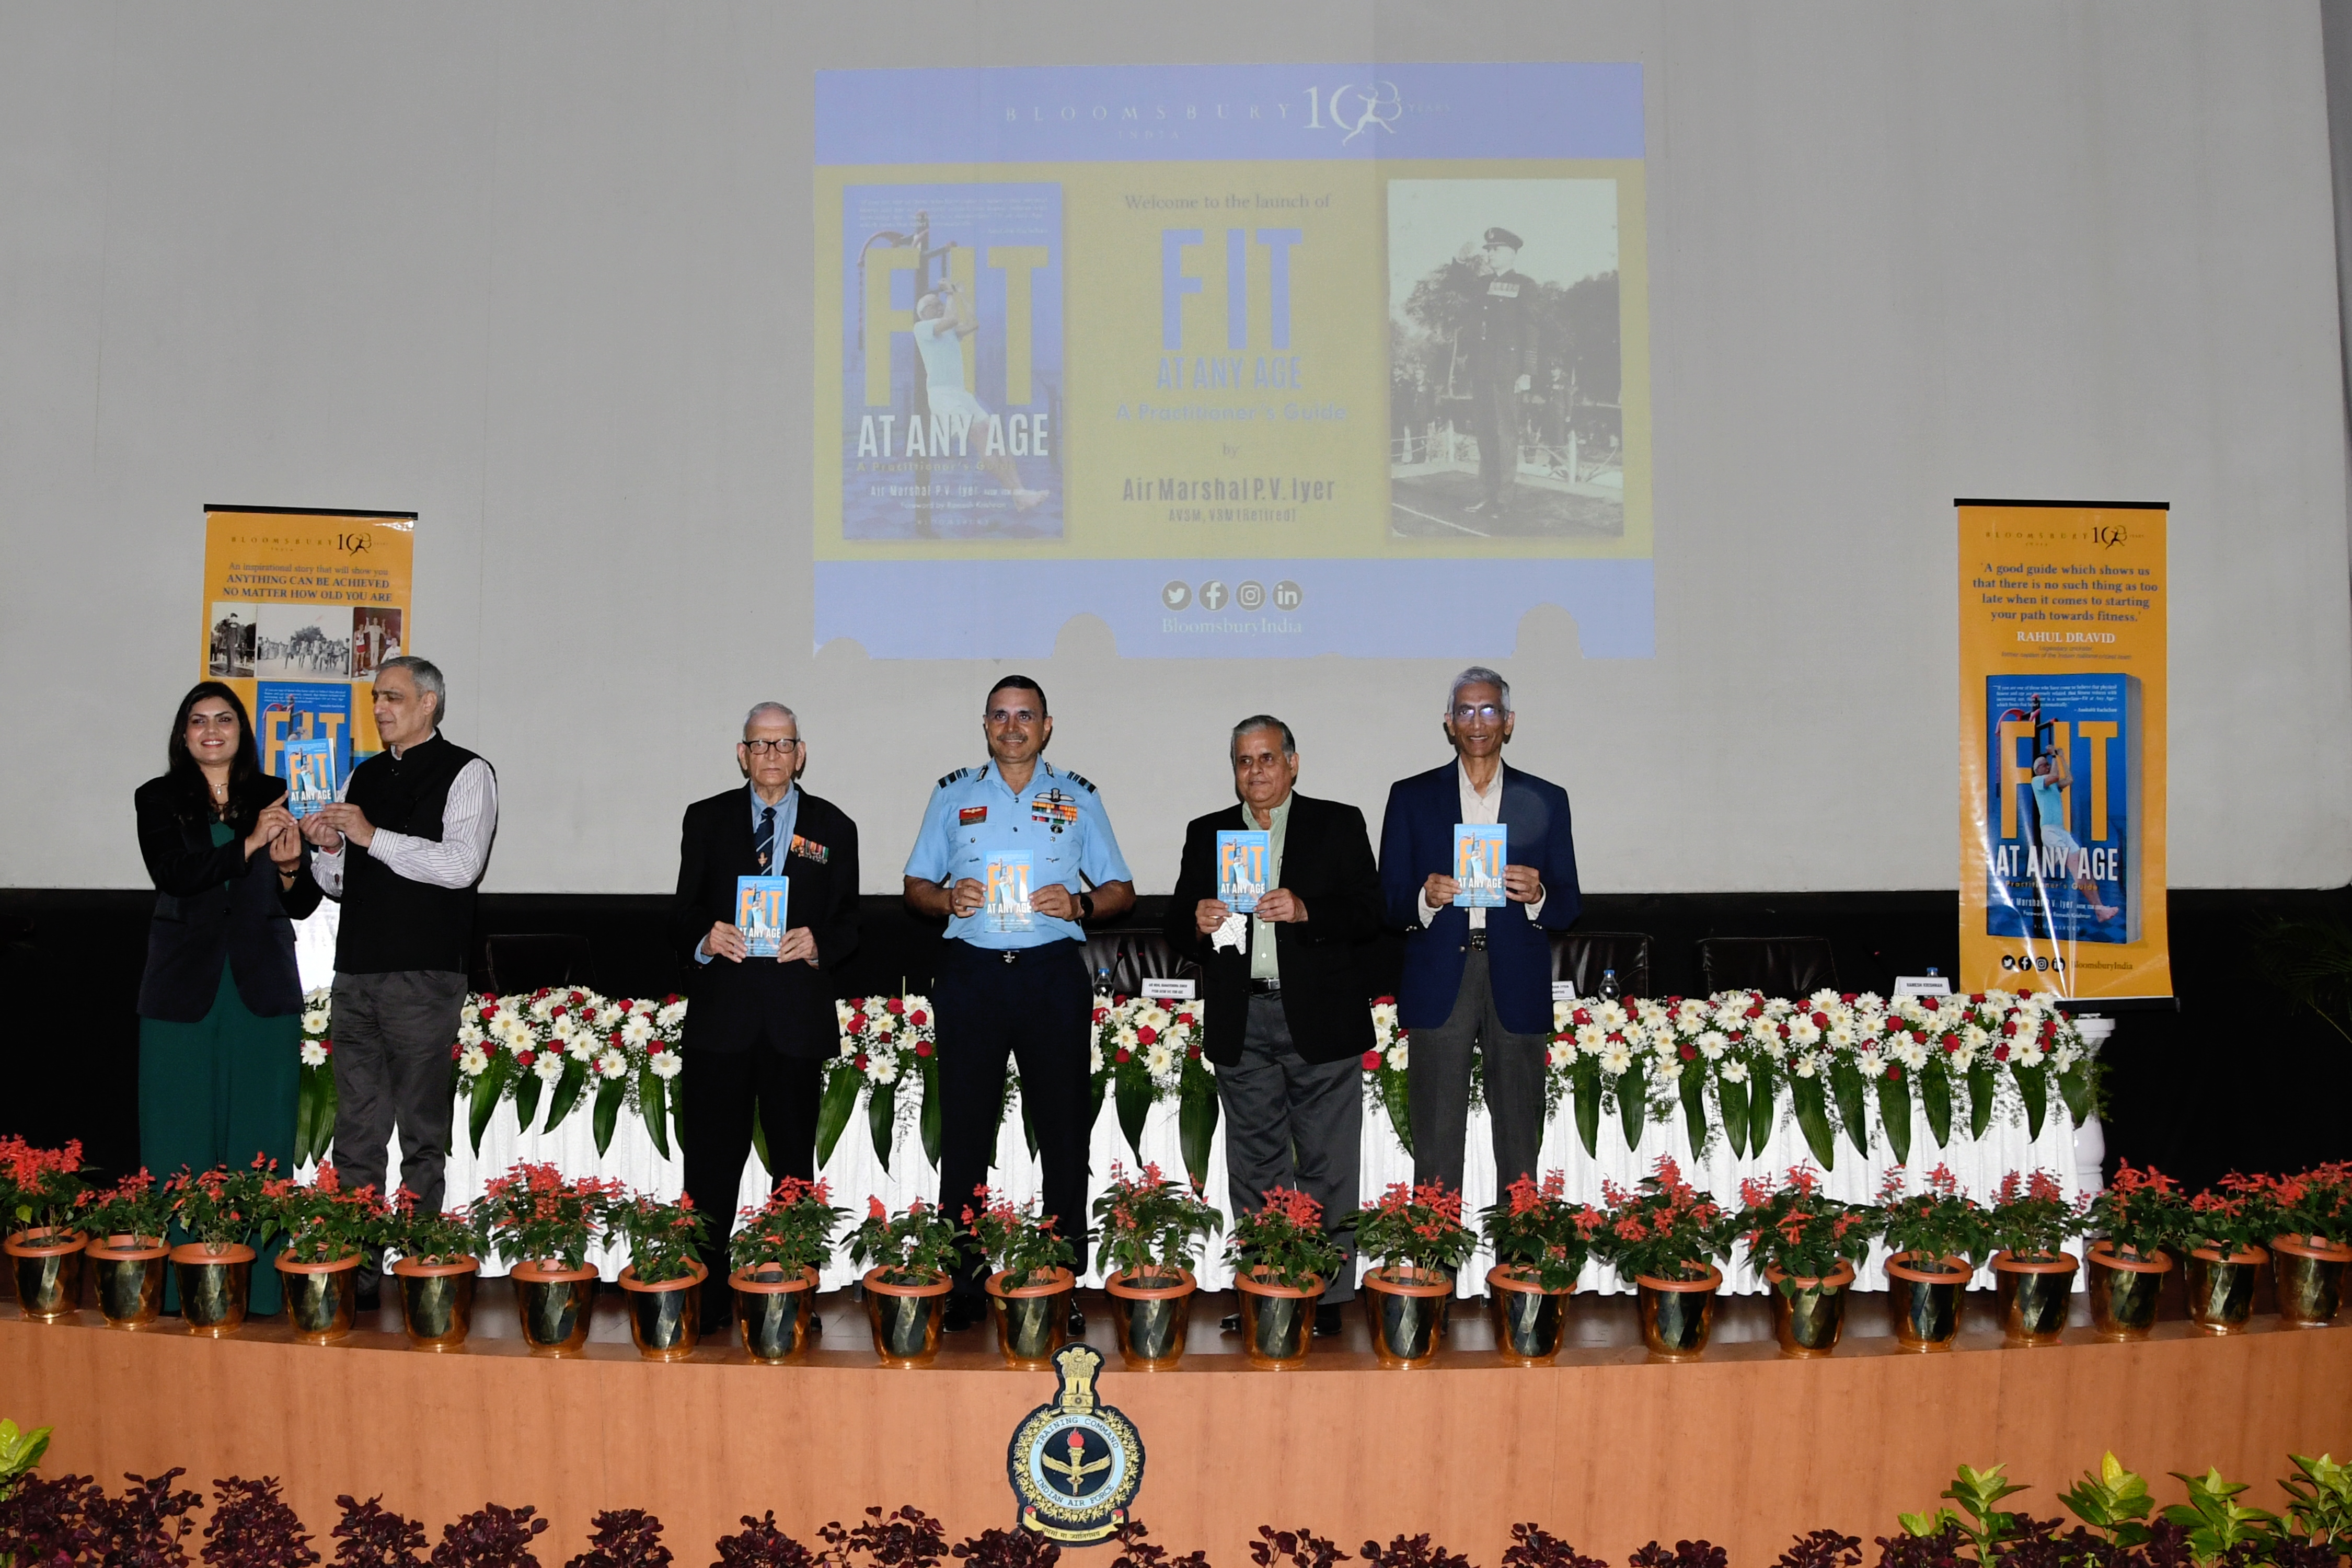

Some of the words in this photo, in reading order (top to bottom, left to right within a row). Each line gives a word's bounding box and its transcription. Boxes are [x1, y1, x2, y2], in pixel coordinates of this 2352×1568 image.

[1006, 103, 1290, 122] BLOOMSBURY
[1118, 130, 1179, 140] INDIA
[1125, 195, 1198, 210] Welcome
[1204, 196, 1219, 209] to
[1225, 194, 1250, 209] the
[1255, 194, 1309, 209] launch
[1315, 194, 1332, 208] of
[1162, 228, 1303, 351] FIT
[865, 246, 1048, 407] FIT
[1157, 357, 1185, 390] AT
[1193, 356, 1244, 389] ANY
[1254, 356, 1302, 389] AGE
[1116, 403, 1131, 421] A
[1283, 402, 1347, 421] Guide
[857, 414, 895, 457] AT
[906, 414, 974, 457] ANY
[985, 413, 1049, 456] AGE
[1223, 442, 1239, 458] by
[871, 486, 884, 497] Air
[890, 485, 930, 497] Marshal
[1122, 477, 1154, 502] Air
[1158, 477, 1248, 502] Marshal
[1292, 477, 1335, 504] Iyer
[1209, 508, 1234, 523] VSM
[232, 537, 332, 546] BLOOMSBURY
[243, 562, 292, 573] inspirational
[294, 564, 314, 574] story
[317, 565, 332, 573] that
[335, 566, 349, 574] will
[352, 567, 371, 575] show
[374, 569, 388, 577] you
[1997, 563, 2023, 575] good
[2027, 563, 2057, 576] guide
[2061, 564, 2095, 574] which
[2100, 565, 2134, 575] shows
[2138, 567, 2150, 575] us
[227, 574, 286, 585] ANYTHING
[290, 577, 313, 585] CAN
[316, 577, 329, 586] BE
[333, 578, 389, 588] ACHIEVED
[1973, 579, 1996, 589] that
[1999, 579, 2028, 589] there
[2032, 580, 2040, 590] is
[2044, 582, 2059, 590] no
[2062, 580, 2088, 590] such
[2092, 580, 2123, 593] thing
[2125, 583, 2137, 592] as
[2140, 582, 2158, 592] too
[223, 587, 238, 596] NO
[242, 588, 287, 598] MATTER
[291, 590, 318, 599] HOW
[321, 591, 342, 600] OLD
[345, 591, 368, 601] YOU
[371, 593, 392, 602] ARE
[1982, 593, 2003, 604] late
[2006, 594, 2037, 605] when
[2040, 595, 2049, 605] it
[2052, 597, 2088, 606] comes
[2091, 596, 2102, 606] to
[2105, 596, 2150, 609] starting
[1991, 612, 2017, 621] your
[2021, 610, 2046, 622] path
[2049, 611, 2094, 621] towards
[1161, 618, 1303, 637] BloomsburyIndia
[2016, 631, 2062, 643] RAHUL
[2066, 632, 2116, 643] DRAVID
[289, 753, 327, 790] FIT
[2000, 721, 2118, 841] FIT
[291, 791, 299, 802] AT
[301, 790, 315, 801] ANY
[317, 789, 331, 800] AGE
[1222, 846, 1265, 882] FIT
[1460, 839, 1503, 877] FIT
[1996, 845, 2020, 877] AT
[2026, 845, 2069, 879] ANY
[2077, 847, 2118, 881] AGE
[988, 865, 1030, 902] FIT
[1221, 883, 1230, 894] AT
[1232, 883, 1248, 894] ANY
[1250, 883, 1265, 894] AGE
[1458, 878, 1467, 888] AT
[1468, 877, 1484, 889] ANY
[1487, 878, 1502, 889] AGE
[740, 891, 783, 927] FIT
[987, 903, 996, 914] AT
[1016, 902, 1032, 913] AGE
[2060, 899, 2073, 909] Iyer
[748, 927, 764, 938] ANY
[766, 928, 781, 938] AGE
[1035, 1416, 1079, 1447] TRAINING
[1085, 1417, 1120, 1449] COMMAND
[1036, 1478, 1064, 1504] INDIAN
[1067, 1498, 1086, 1507] AIR
[1090, 1483, 1115, 1505] FORCE
